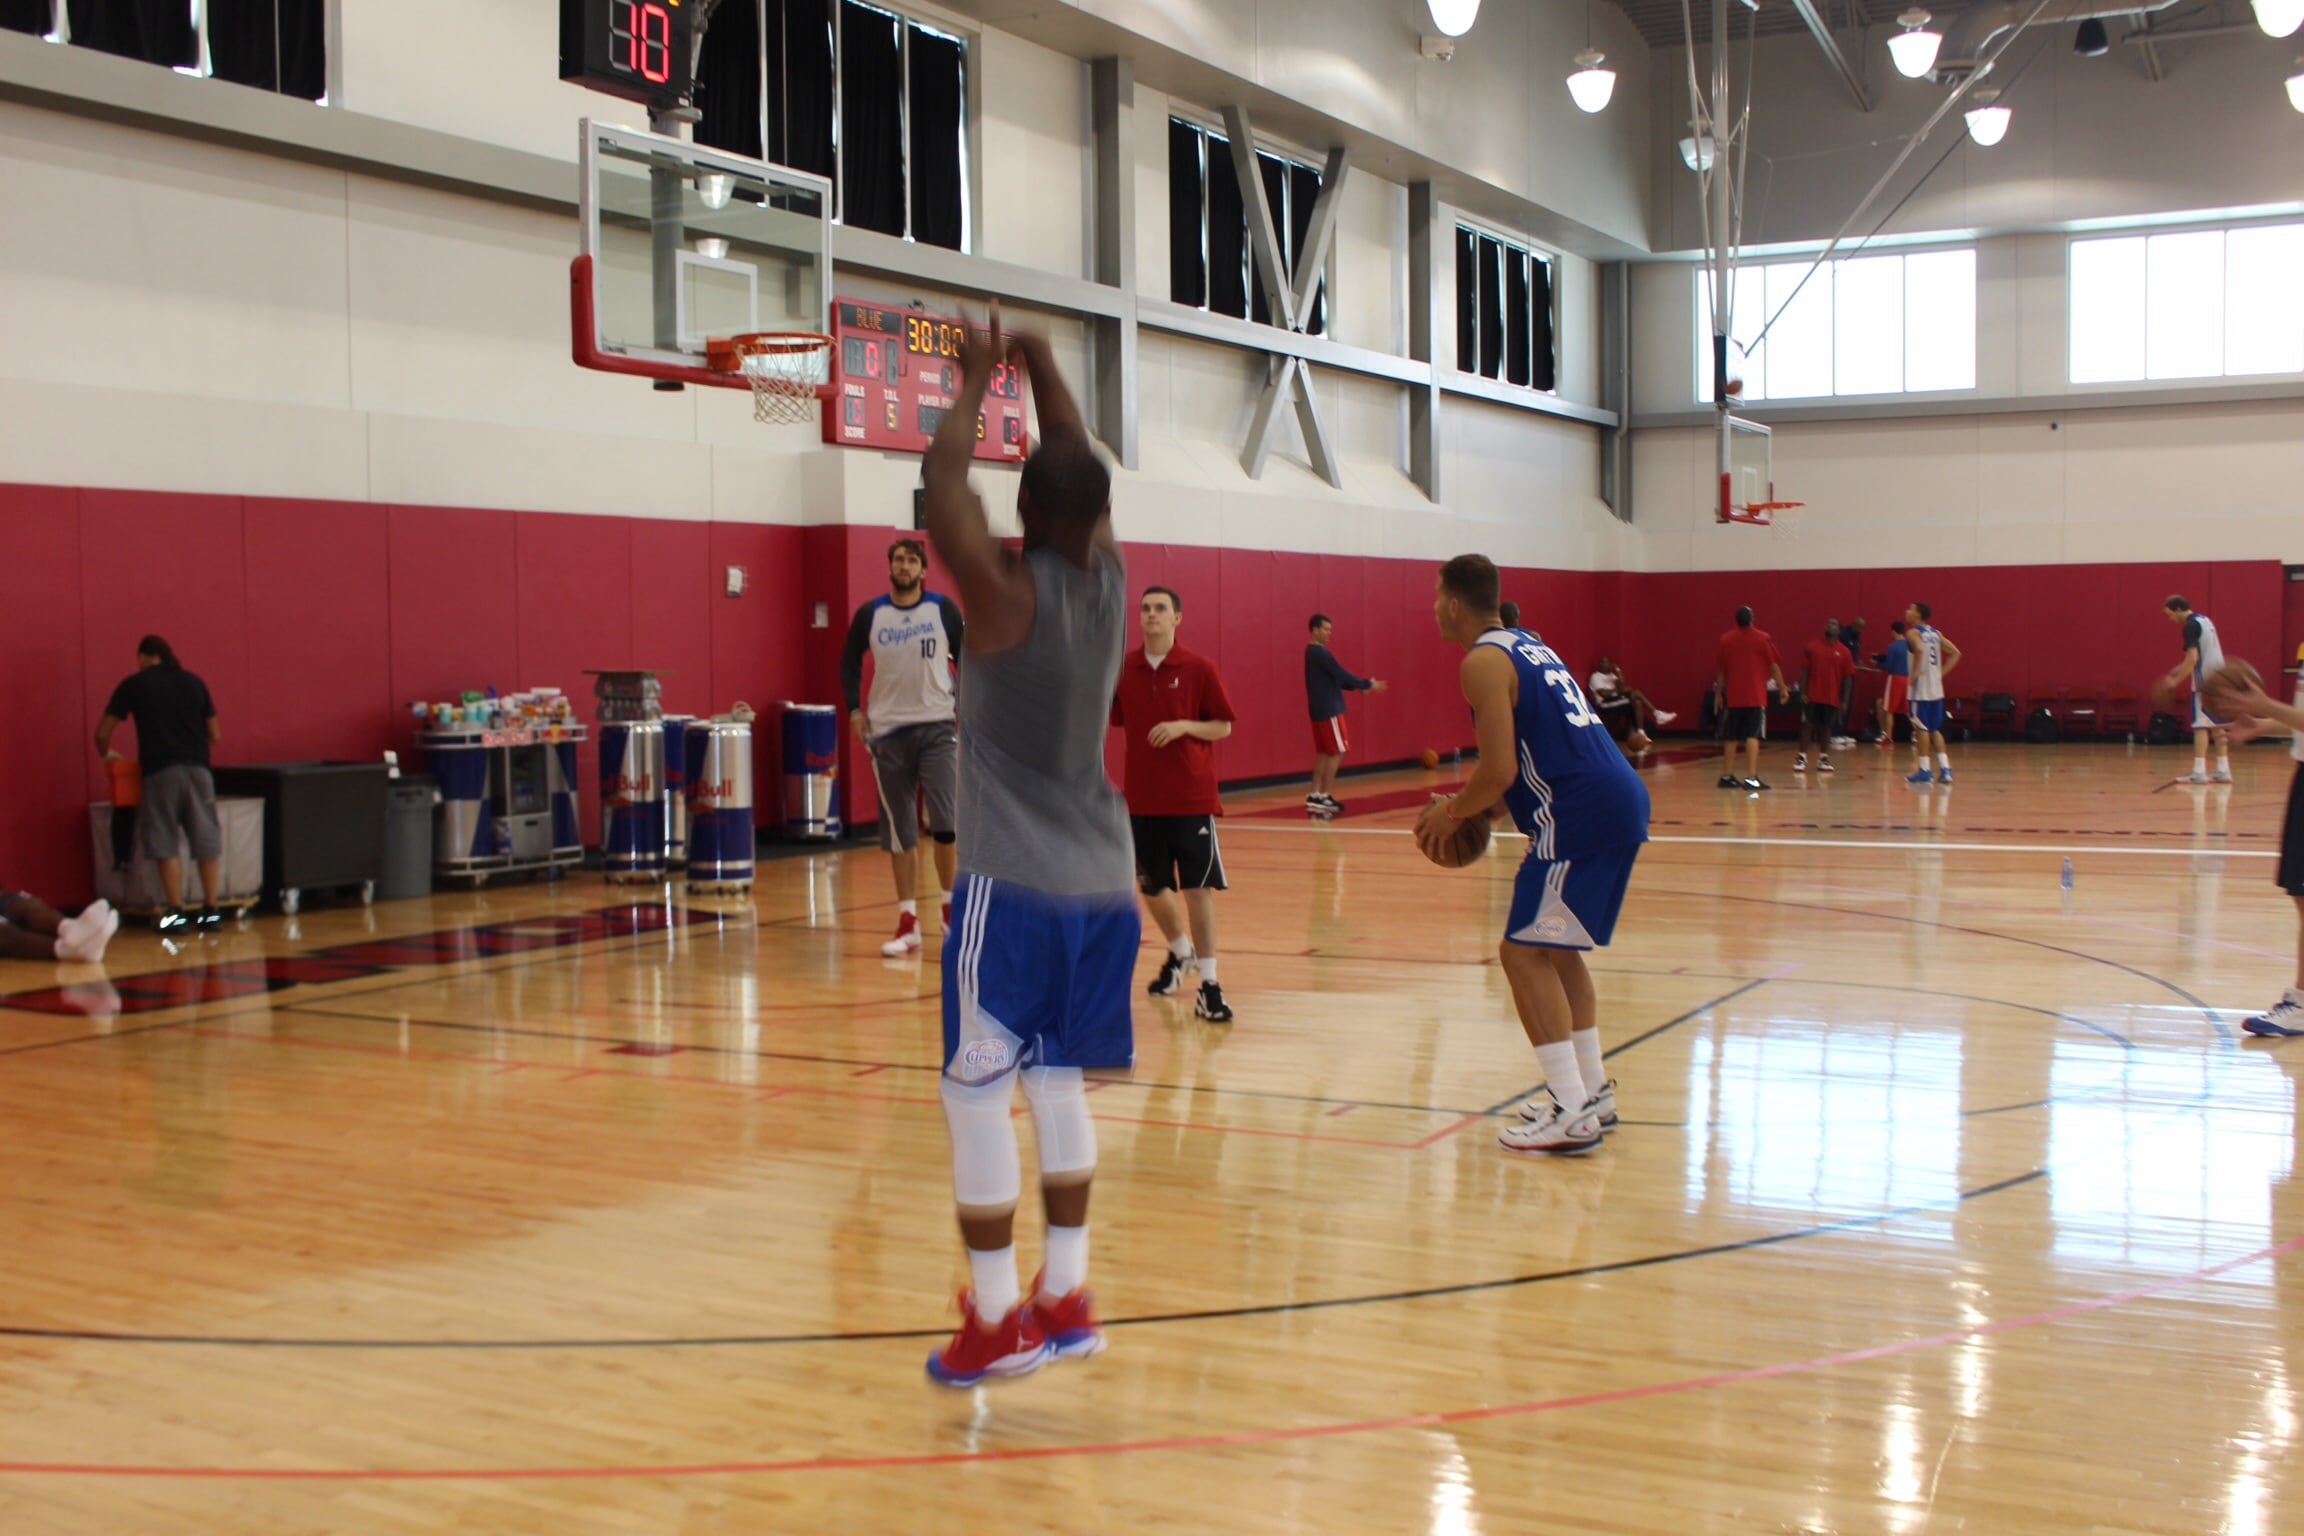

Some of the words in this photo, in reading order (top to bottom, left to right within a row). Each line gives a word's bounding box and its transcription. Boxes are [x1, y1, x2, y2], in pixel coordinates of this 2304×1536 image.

[629, 2, 670, 84] 10
[856, 306, 883, 331] BLUE
[844, 383, 865, 398] FOULS
[918, 394, 940, 408] PLAYER
[844, 425, 866, 440] SCORE
[878, 622, 936, 647] Clippers
[921, 638, 937, 659] 10
[617, 774, 651, 792] Bull
[699, 778, 734, 798] Bull
